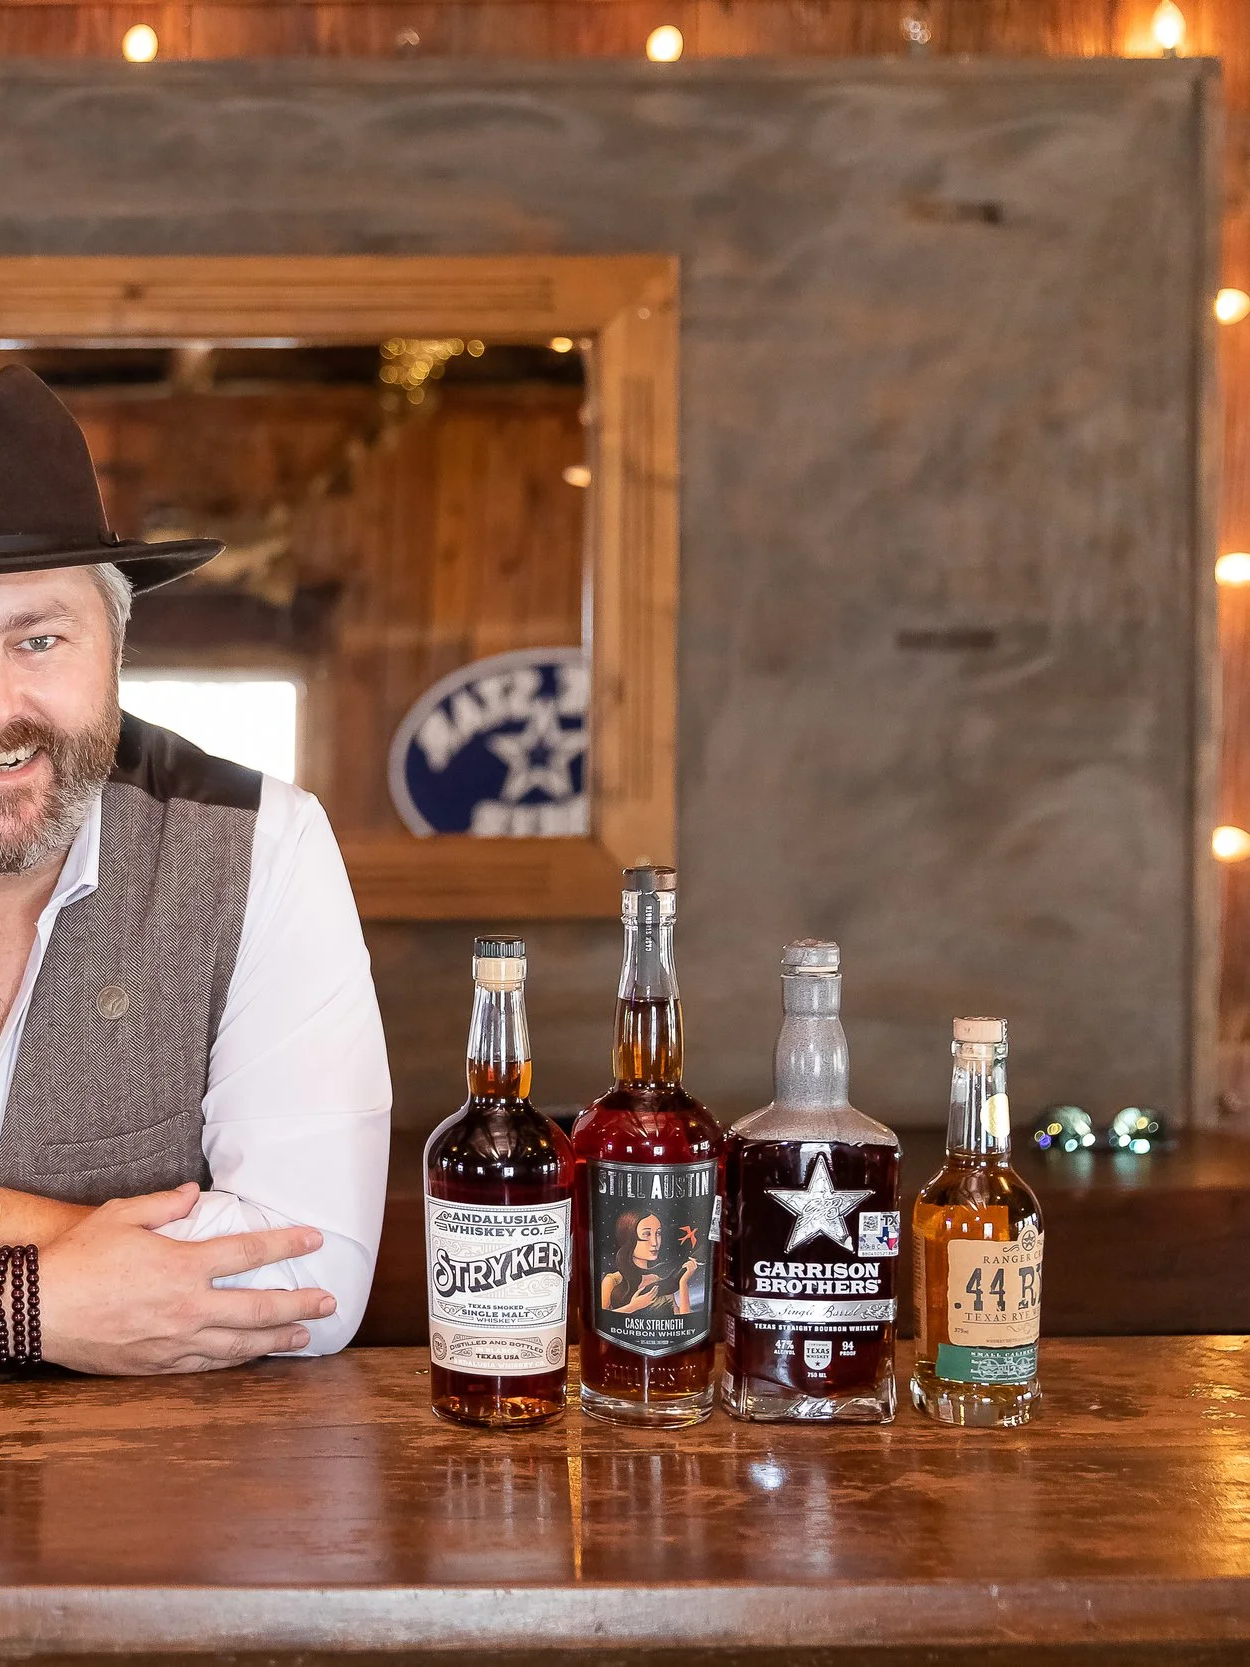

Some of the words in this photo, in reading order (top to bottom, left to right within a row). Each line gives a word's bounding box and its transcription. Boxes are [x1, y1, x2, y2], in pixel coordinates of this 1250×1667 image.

[599, 1169, 645, 1199] STILL
[651, 1171, 710, 1199] AUSTIN
[452, 1212, 538, 1224] ANDALUSIA
[447, 1224, 516, 1237] WHISKEY
[521, 1227, 543, 1236] CO.
[983, 1255, 1031, 1264] RANGER
[433, 1241, 564, 1298] STRYKER
[754, 1260, 881, 1279] GARRISON
[755, 1277, 881, 1294] BROTHERS
[461, 1309, 502, 1318] SINGLE
[965, 1312, 1007, 1322] TEXAS
[625, 1317, 645, 1330] CASK
[646, 1318, 684, 1331] STRENGTH
[610, 1327, 655, 1337] BOURBON
[658, 1328, 696, 1337] WHISKEY
[450, 1340, 488, 1350] DISTILLED
[509, 1341, 544, 1353] BOTTLED
[775, 1340, 794, 1350] 47%
[841, 1341, 854, 1350] 94
